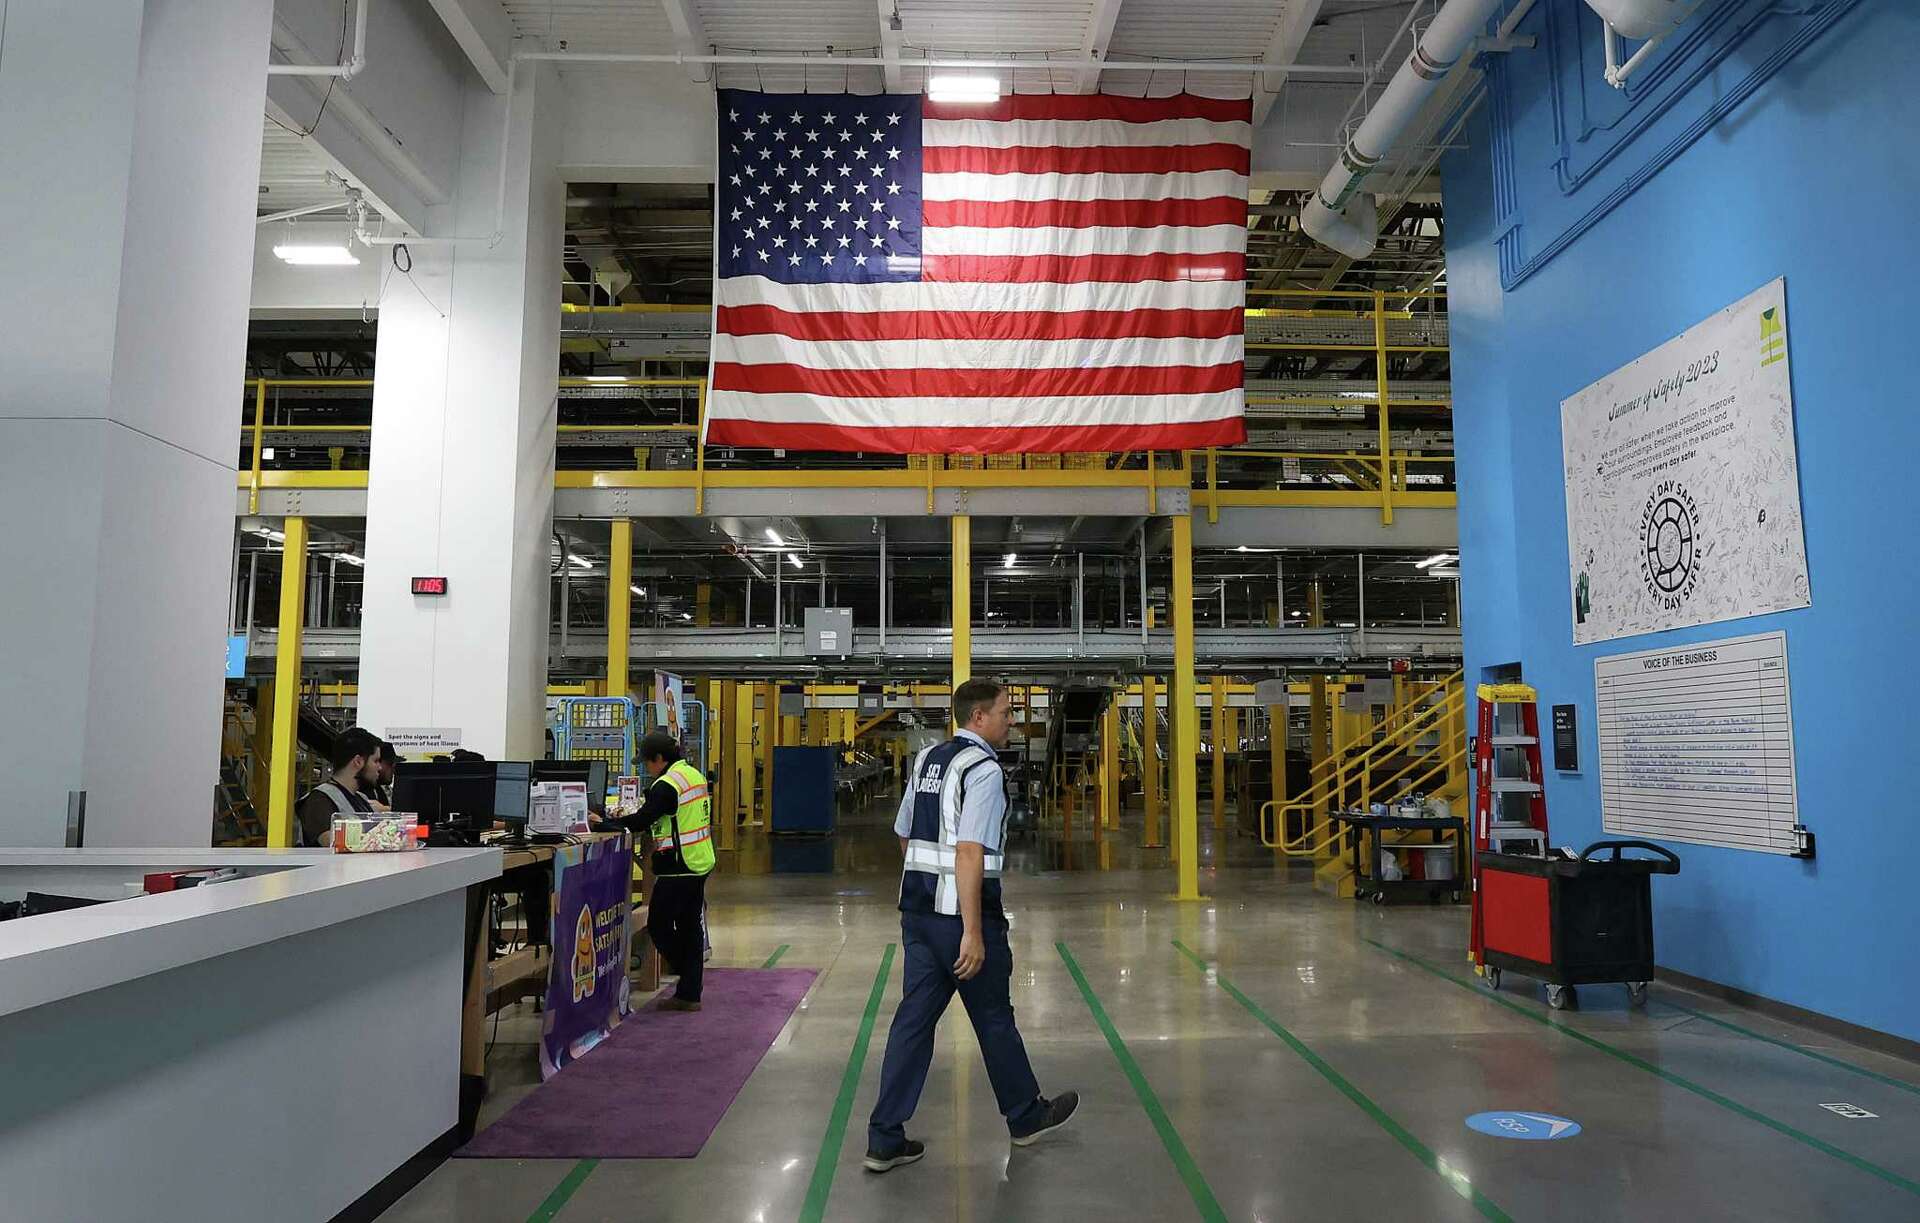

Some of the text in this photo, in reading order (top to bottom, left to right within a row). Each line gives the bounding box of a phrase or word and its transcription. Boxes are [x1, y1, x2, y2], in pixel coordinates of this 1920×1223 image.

[1609, 350, 1719, 421] Summer of Safety 2023
[1665, 421, 1678, 433] take
[1679, 411, 1699, 426] action
[1700, 407, 1707, 417] to
[1708, 395, 1736, 413] improve
[1684, 417, 1712, 436] feedback
[1714, 410, 1727, 423] and
[1653, 462, 1668, 473] every
[1669, 457, 1680, 466] day
[1640, 480, 1699, 541] EVERY DAY SAFER
[1641, 549, 1701, 610] EVERY DAY SAFER
[1642, 650, 1718, 669] VOICE OF THE BUSINESS
